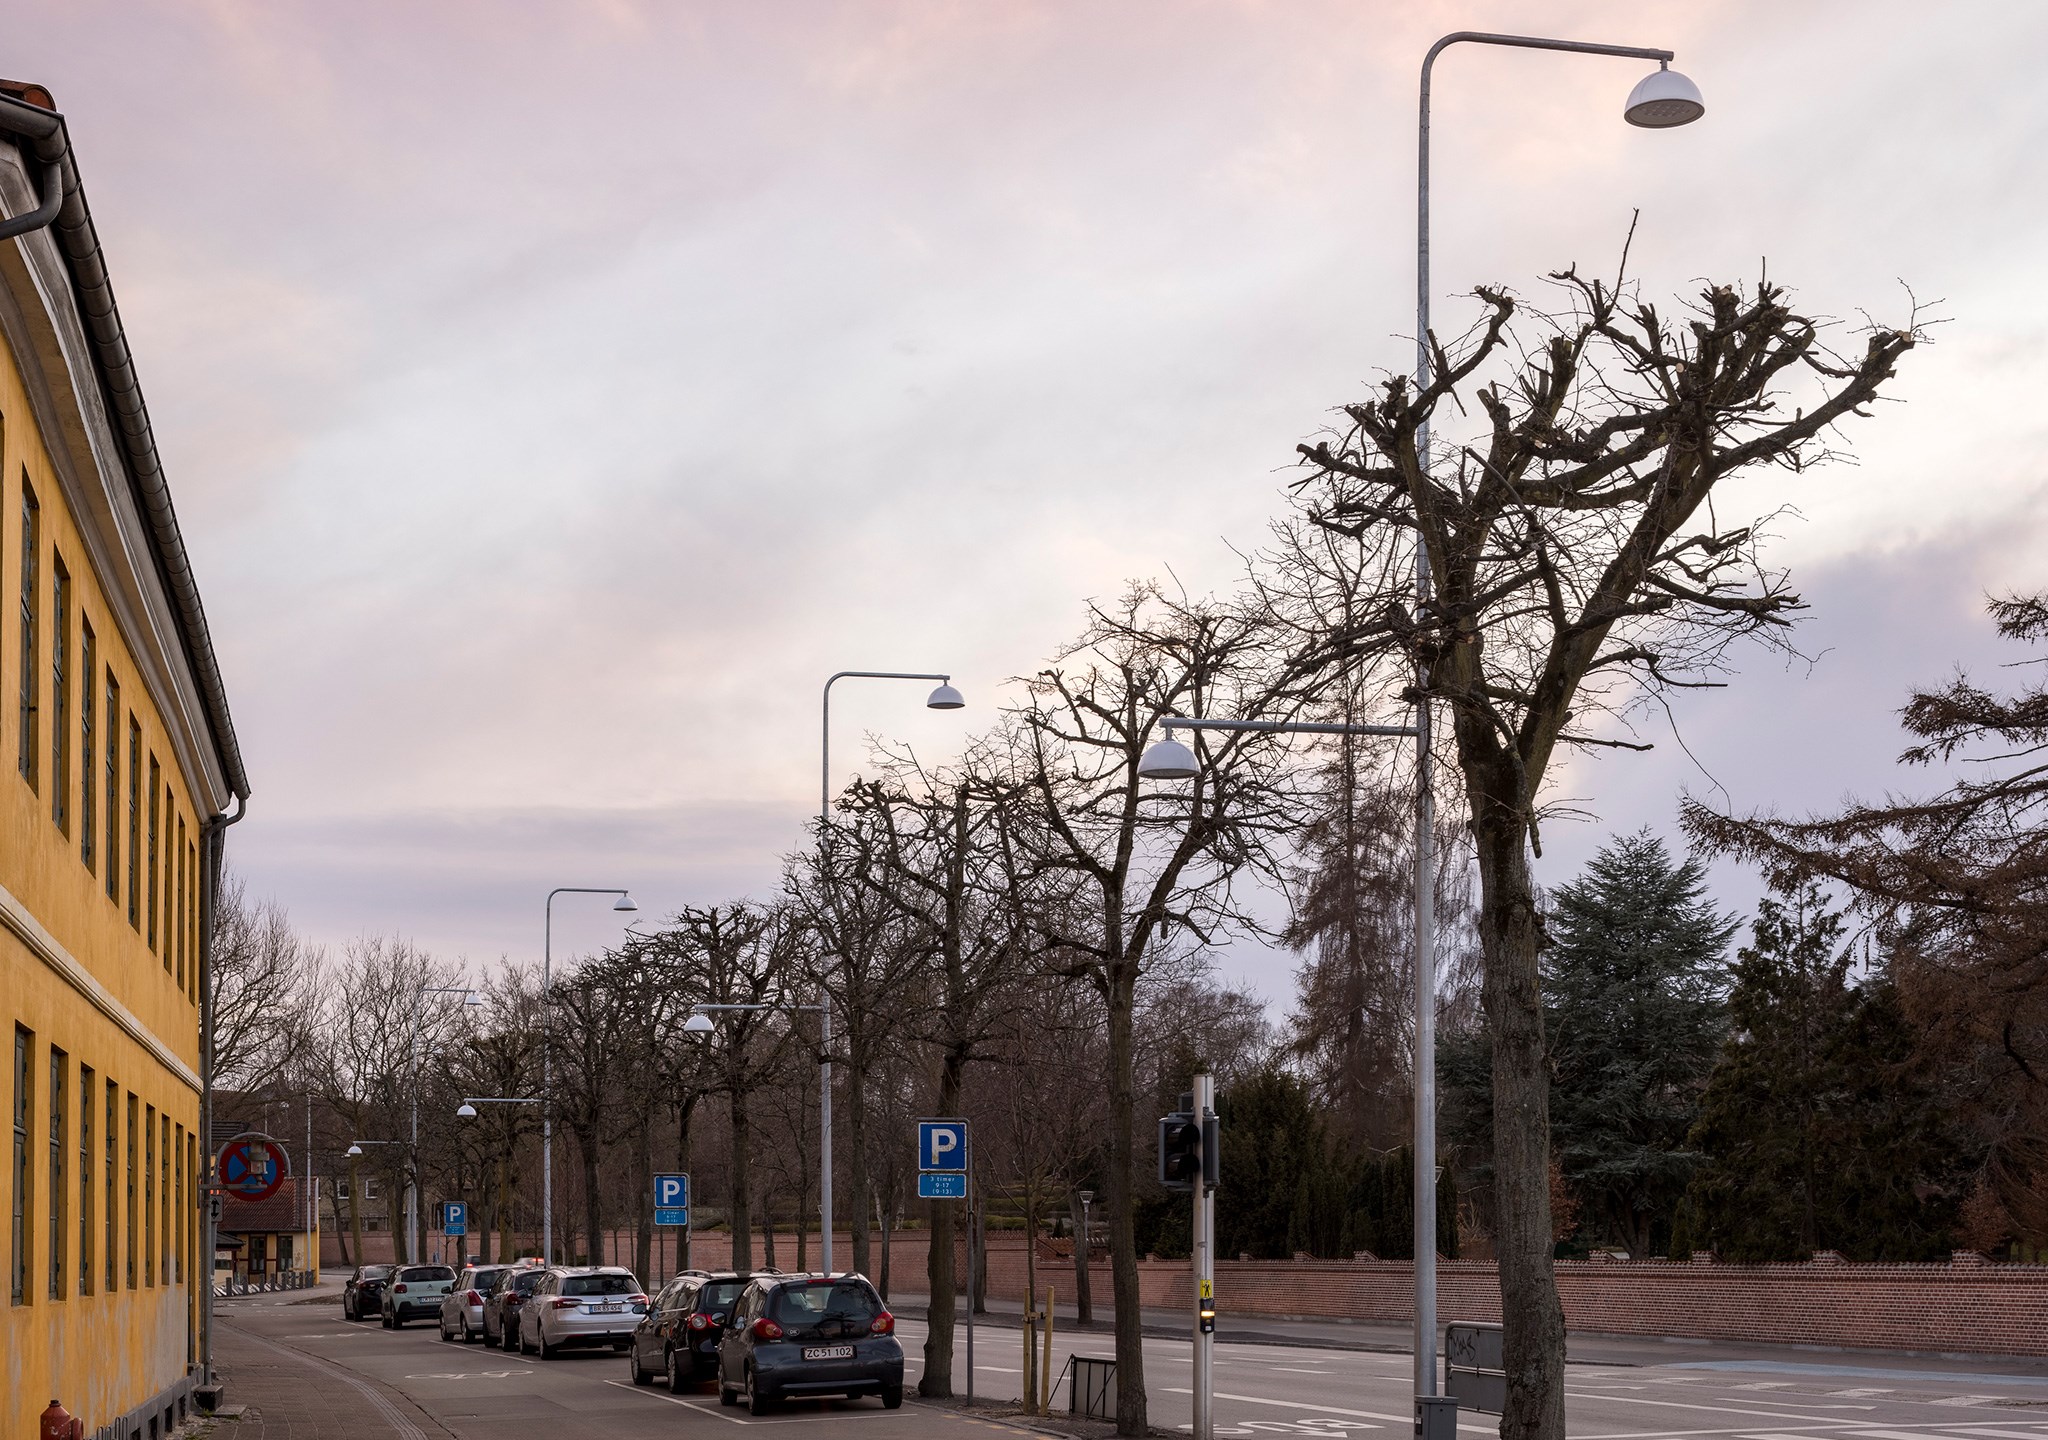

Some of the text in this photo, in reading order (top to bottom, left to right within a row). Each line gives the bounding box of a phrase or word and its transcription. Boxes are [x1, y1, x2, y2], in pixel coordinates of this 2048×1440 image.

[931, 1129, 957, 1164] P
[663, 1180, 680, 1204] P
[450, 1206, 462, 1222] P
[806, 1347, 852, 1358] ZC 51 102
[1178, 1418, 1386, 1434] BUS
